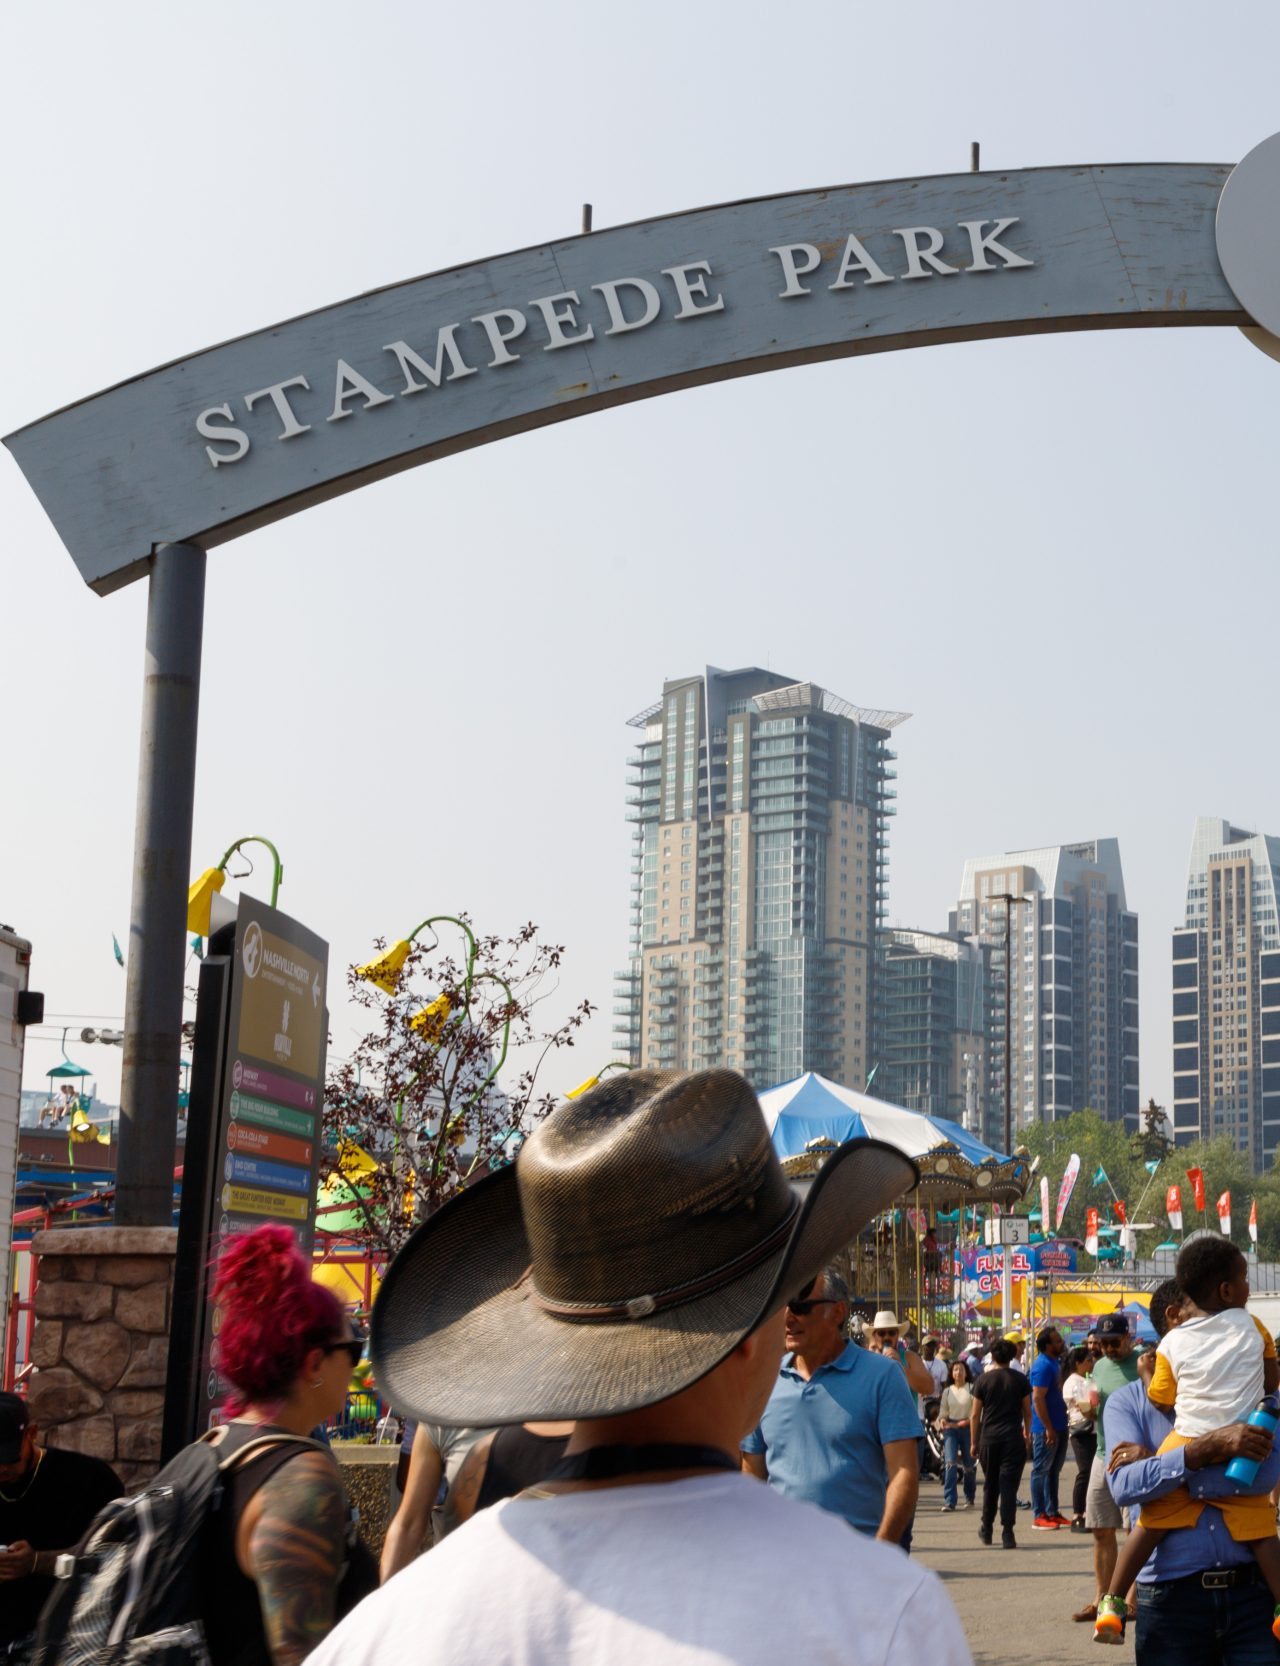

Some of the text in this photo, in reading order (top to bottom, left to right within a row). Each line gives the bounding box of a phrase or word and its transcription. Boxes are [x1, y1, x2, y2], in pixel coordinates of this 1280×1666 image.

[195, 216, 1034, 469] STAMPEDE PARK
[263, 949, 293, 977] NASHVILLE
[1012, 1230, 1019, 1242] 3
